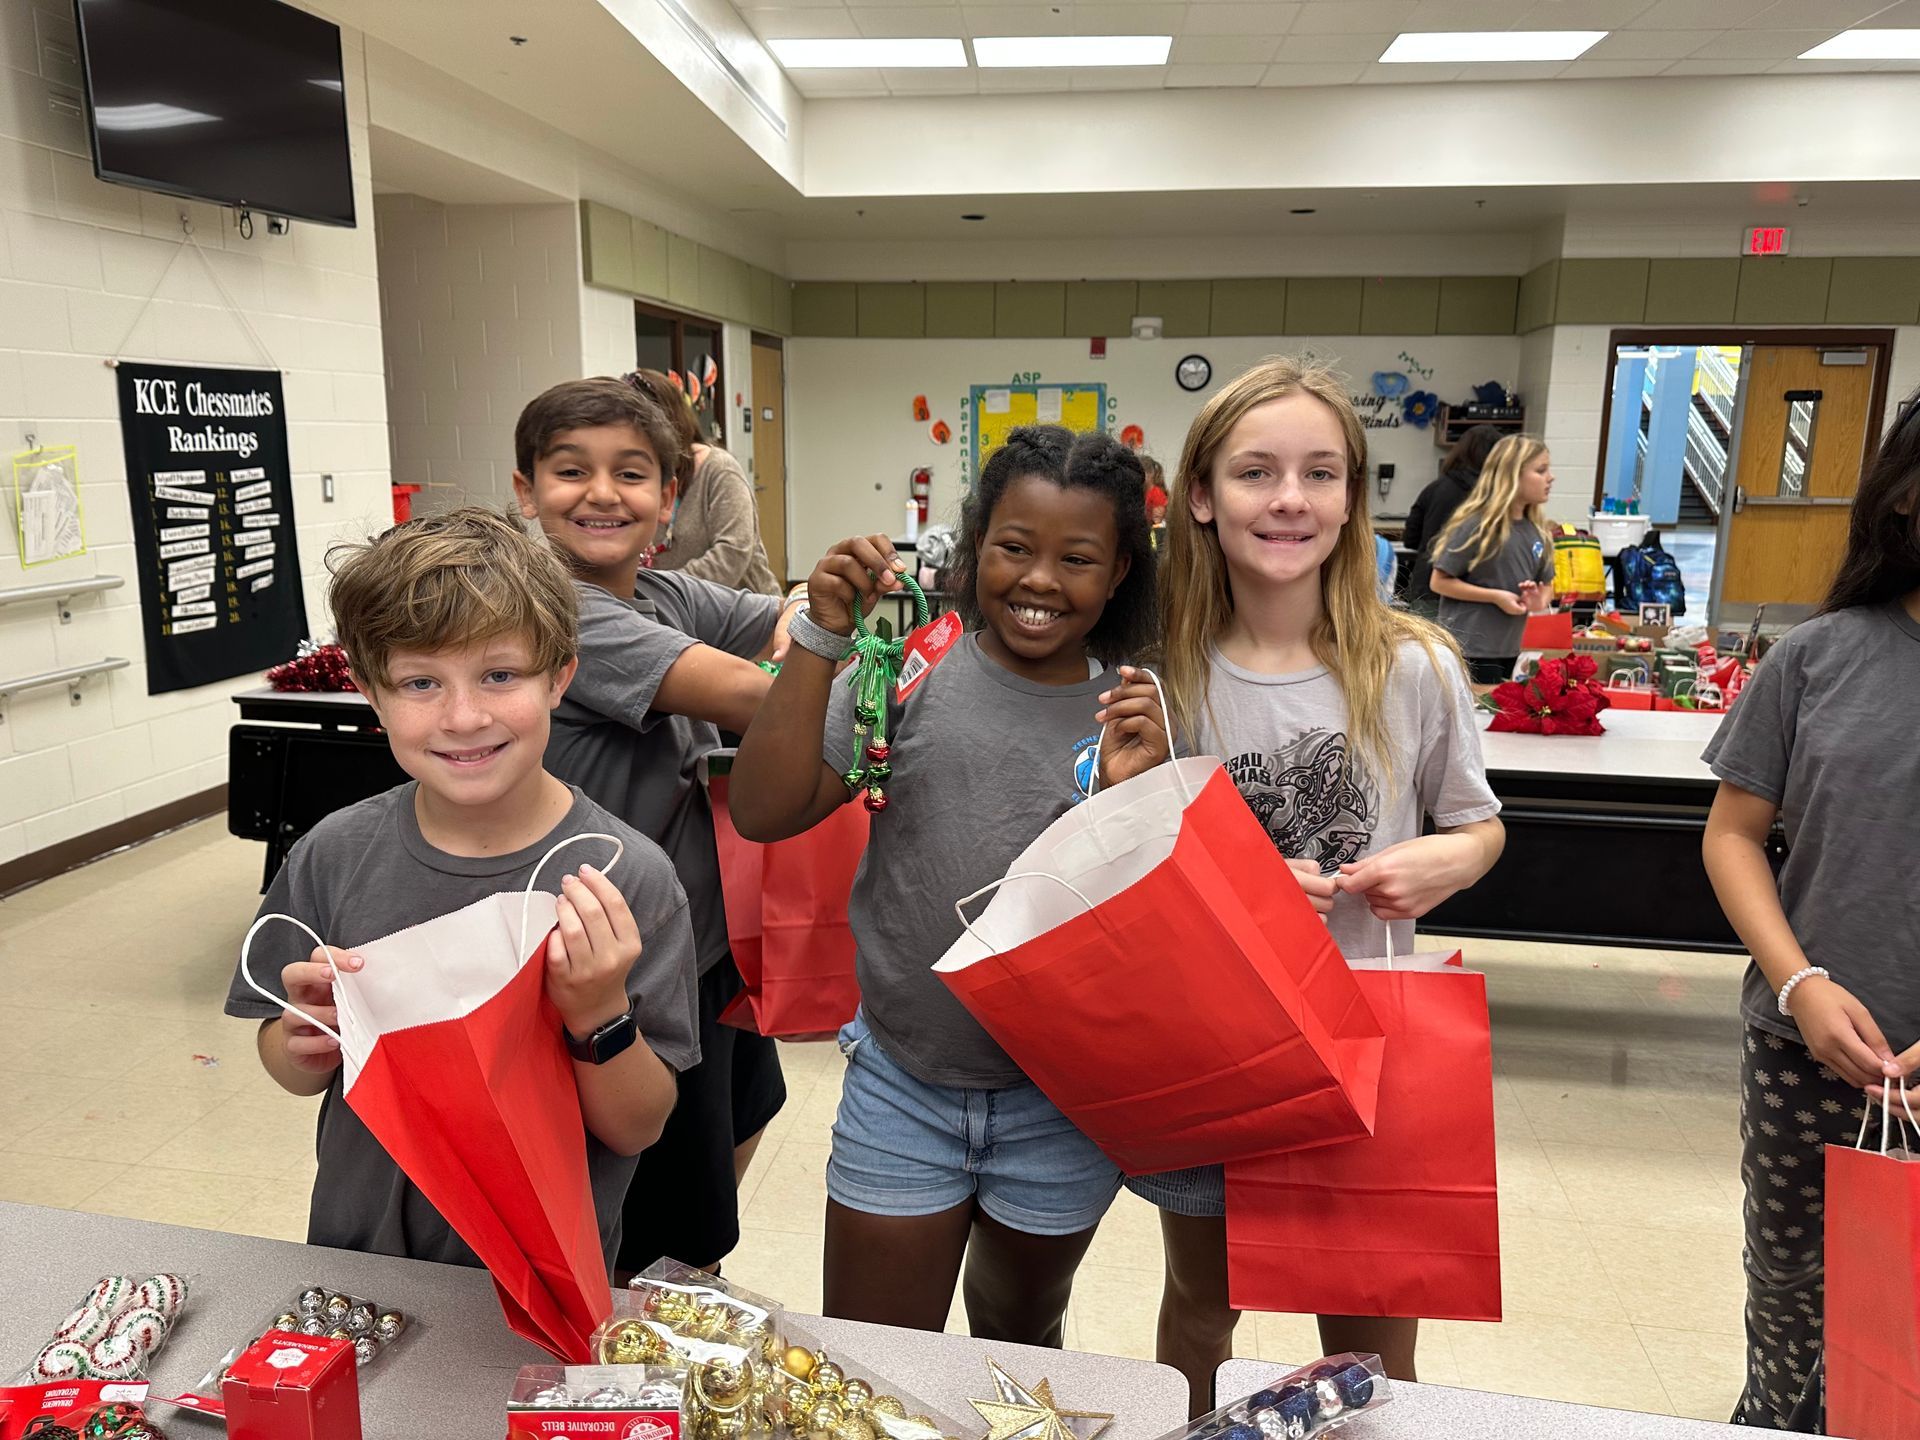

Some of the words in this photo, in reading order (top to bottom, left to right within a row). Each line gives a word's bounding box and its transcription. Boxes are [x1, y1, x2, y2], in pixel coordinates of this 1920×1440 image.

[1751, 227, 1785, 253] EXIT
[1012, 372, 1041, 385] ASP
[133, 378, 180, 415] KCE
[185, 382, 273, 417] Chessmates
[168, 425, 259, 458] Rankings
[981, 434, 990, 446] 3
[272, 1339, 319, 1351] ORNAMENTS
[541, 1421, 565, 1432] BELLS
[567, 1421, 616, 1432] DECORATIVE
